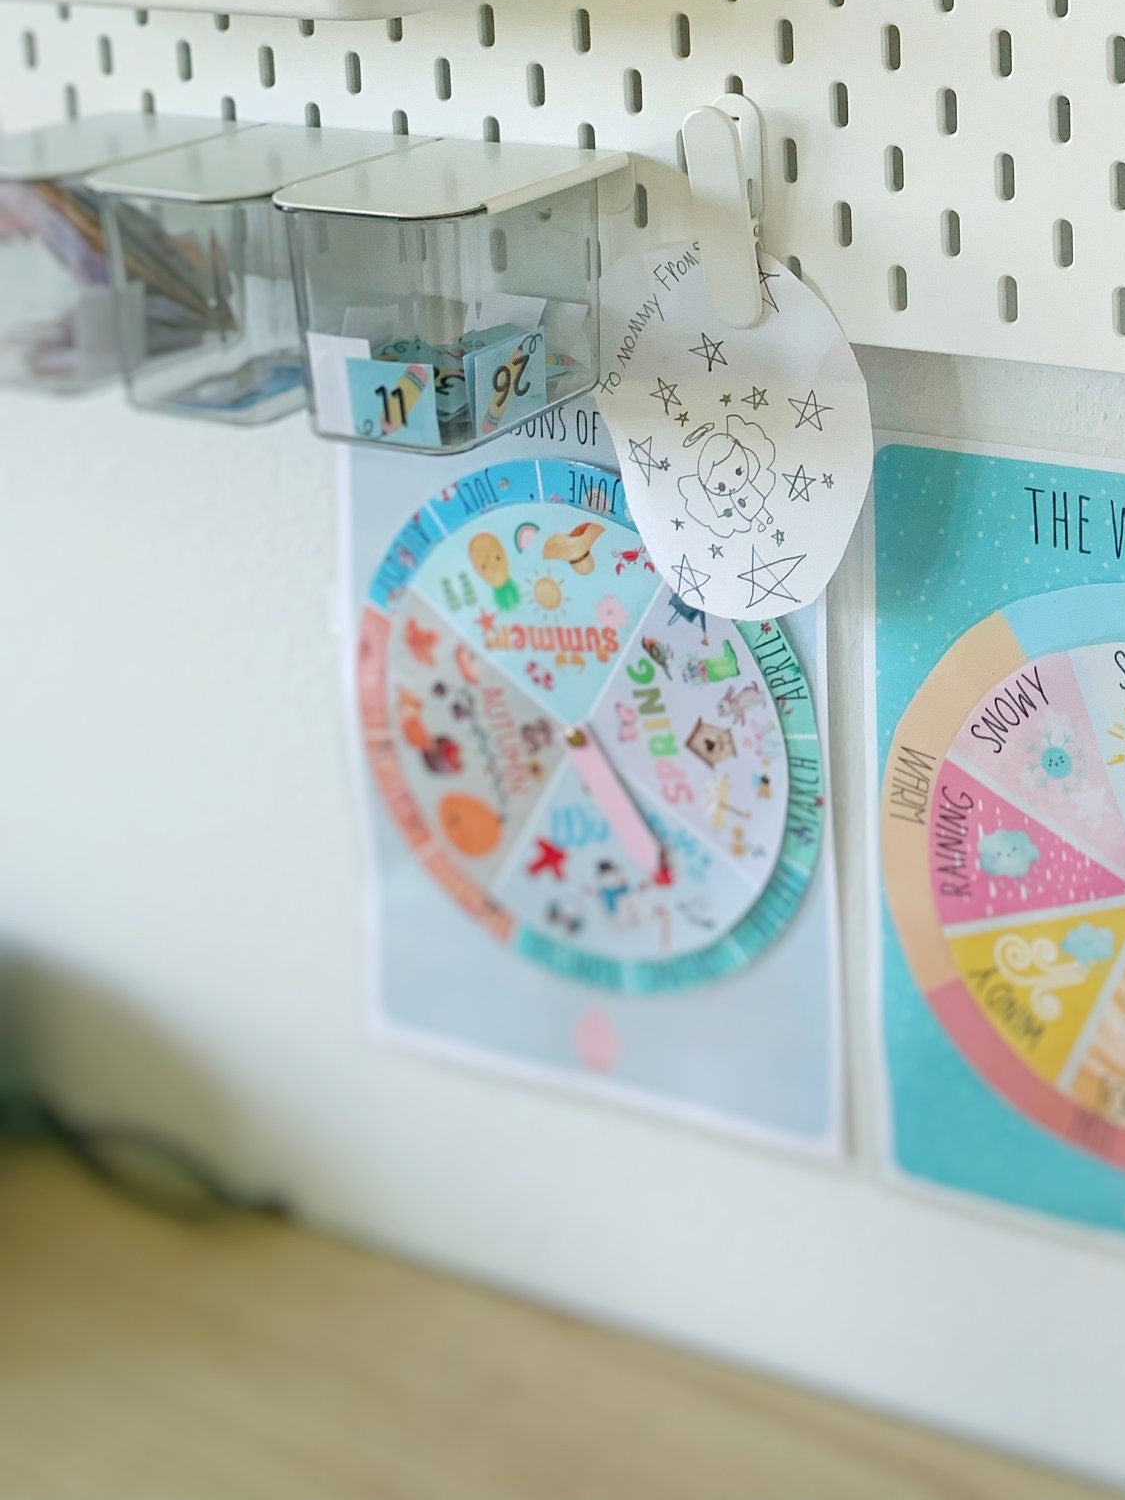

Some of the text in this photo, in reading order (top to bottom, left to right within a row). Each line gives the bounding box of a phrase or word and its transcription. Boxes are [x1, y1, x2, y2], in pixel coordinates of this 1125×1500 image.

[374, 384, 408, 428] 11
[576, 408, 600, 447] OF
[568, 469, 622, 517] JUNE
[1023, 486, 1093, 556] THE
[752, 629, 809, 701] APRIL
[625, 657, 696, 805] SPRING
[970, 666, 1053, 755] SNOWY
[889, 745, 938, 827] WARM
[938, 785, 975, 898] RAINING
